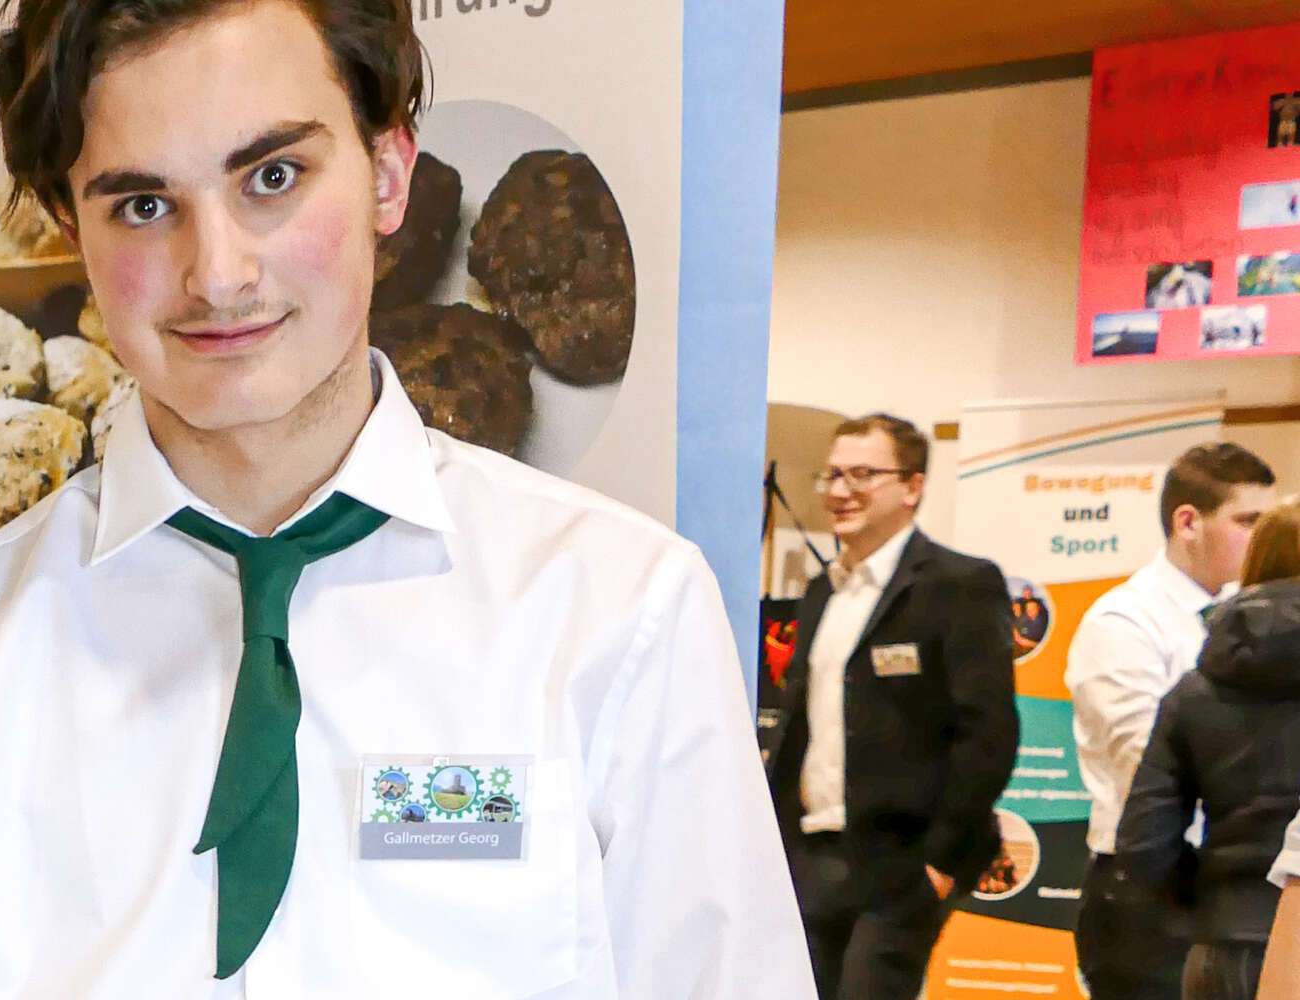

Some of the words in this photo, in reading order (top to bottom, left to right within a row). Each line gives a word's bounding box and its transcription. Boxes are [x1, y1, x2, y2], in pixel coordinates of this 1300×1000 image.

[1025, 474, 1153, 493] Bewegung
[1063, 504, 1109, 522] und
[1051, 535, 1118, 556] Sport
[383, 831, 455, 845] Gallmetzer
[458, 831, 500, 847] Georg
